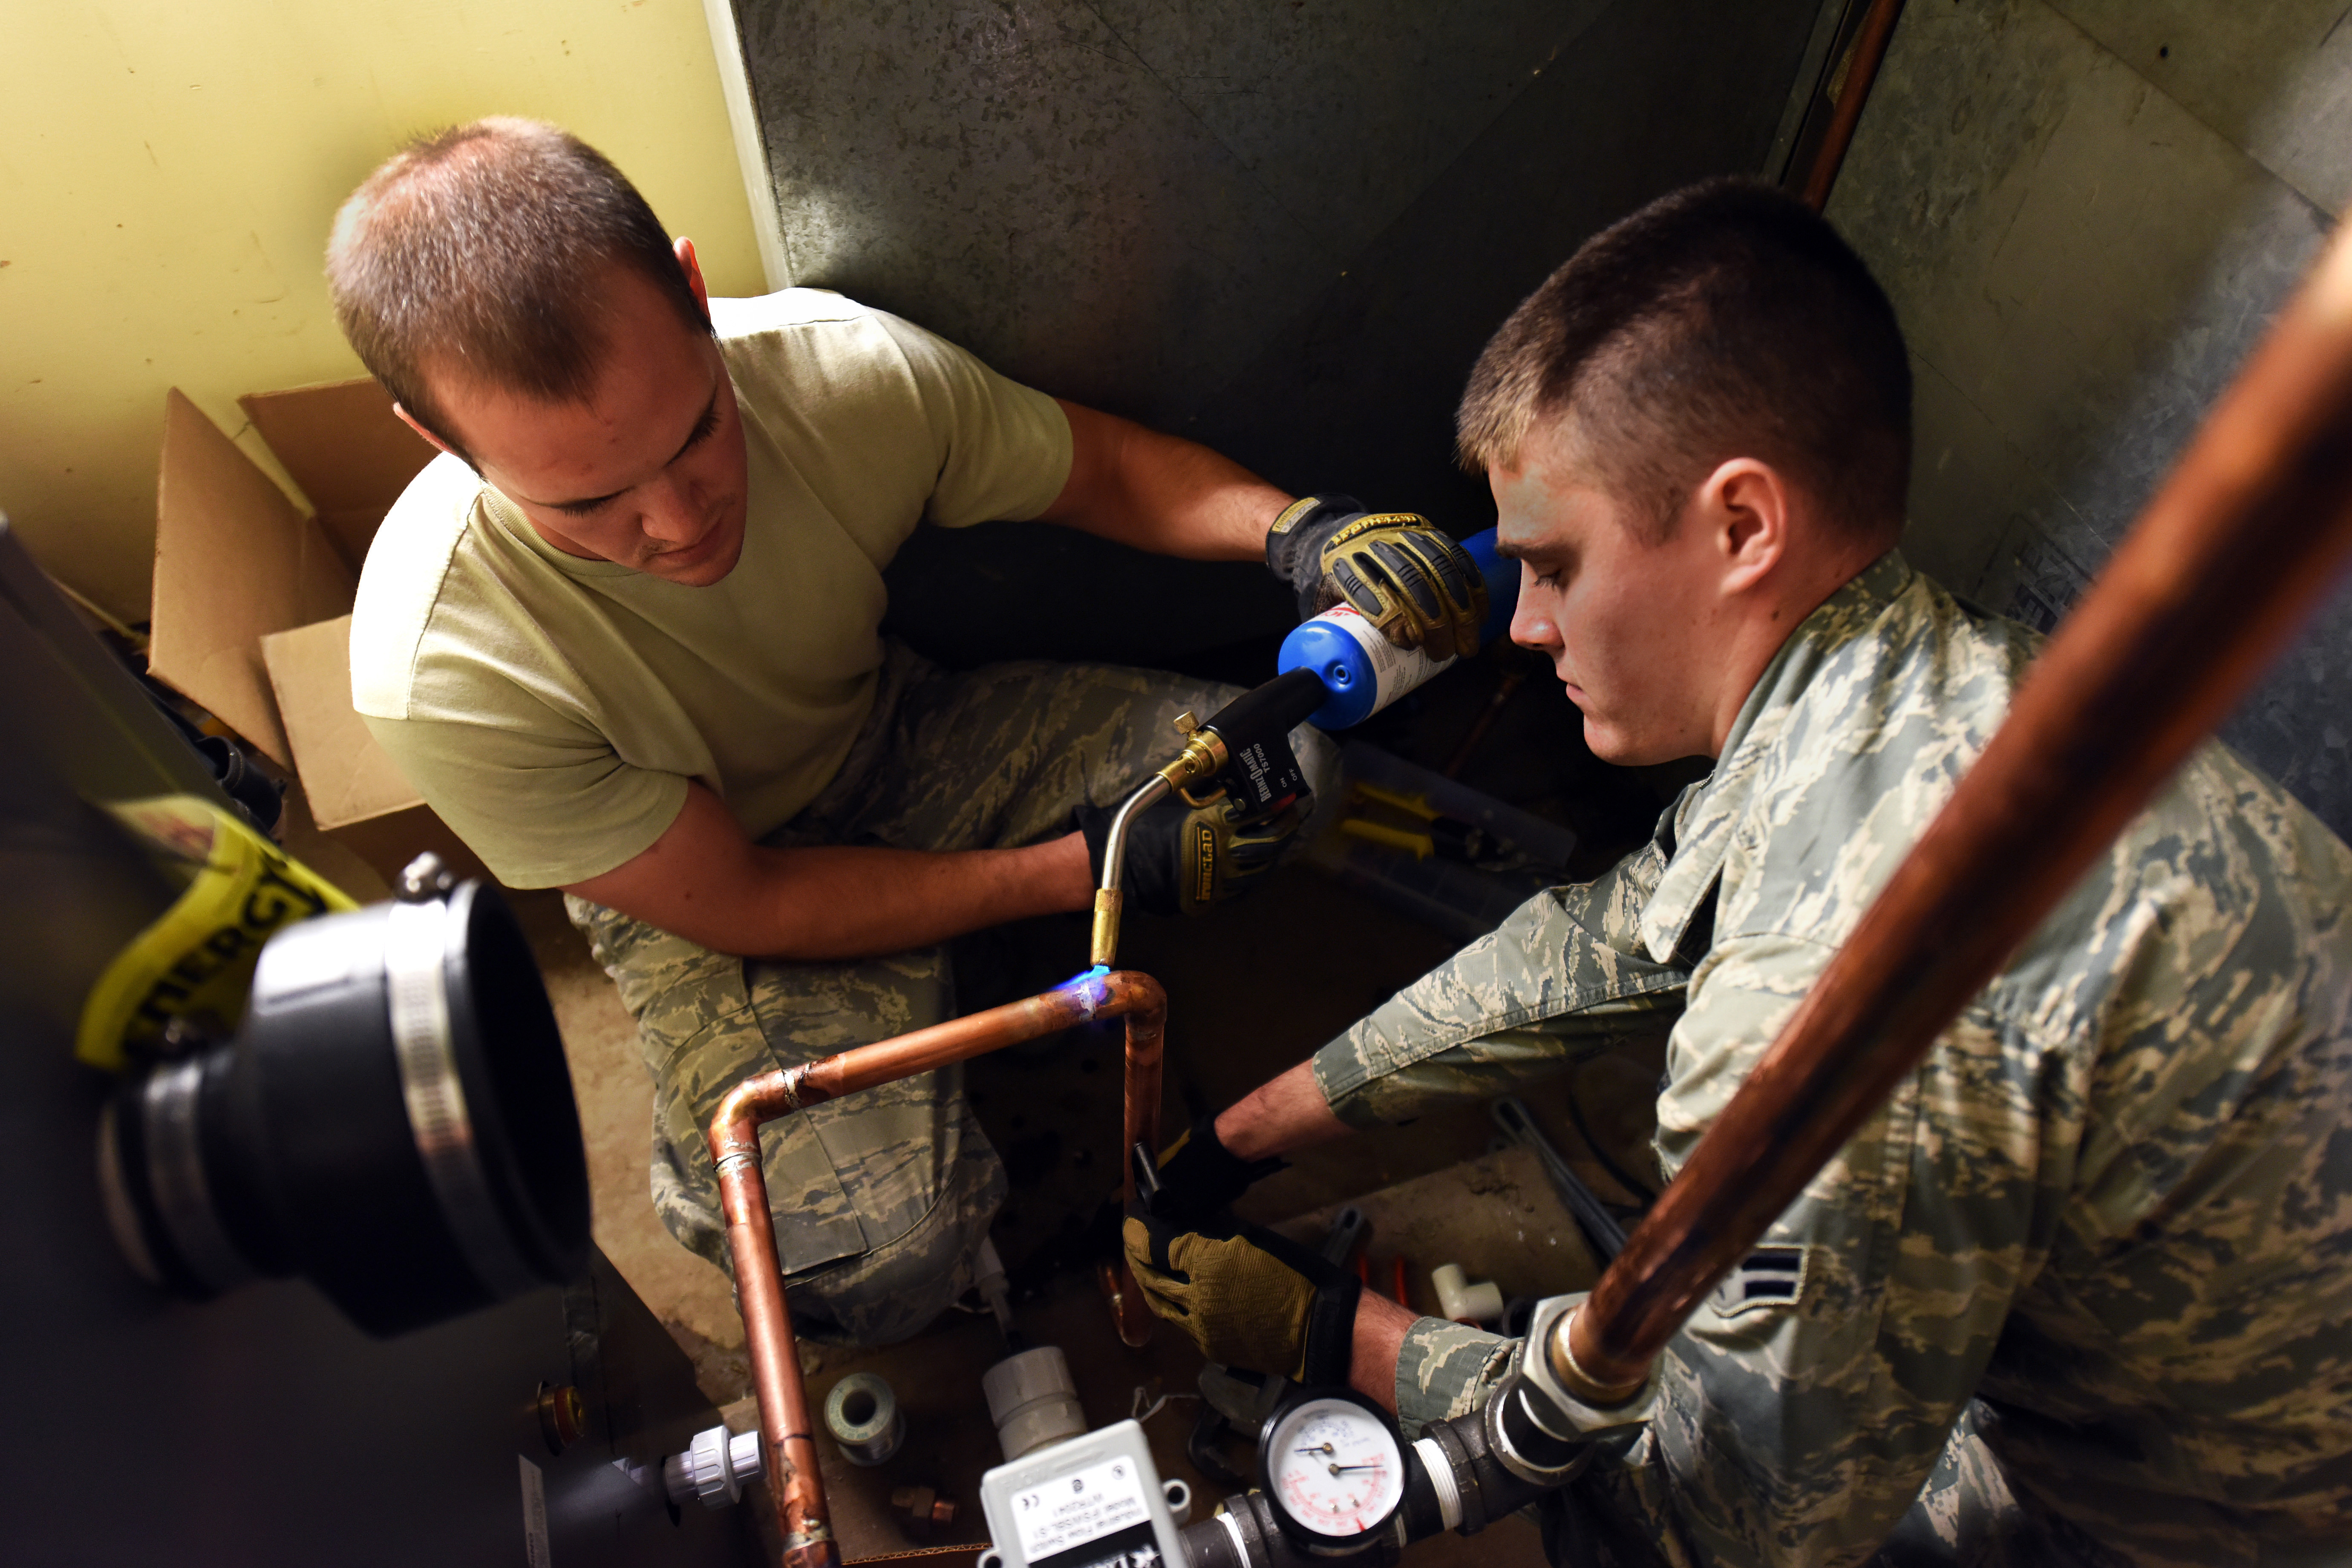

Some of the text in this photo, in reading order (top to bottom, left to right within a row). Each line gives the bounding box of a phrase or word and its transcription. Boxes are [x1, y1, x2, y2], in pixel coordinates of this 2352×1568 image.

[1254, 743, 1270, 774] TS7000
[1289, 768, 1297, 781] OFF
[1280, 777, 1287, 788] ON
